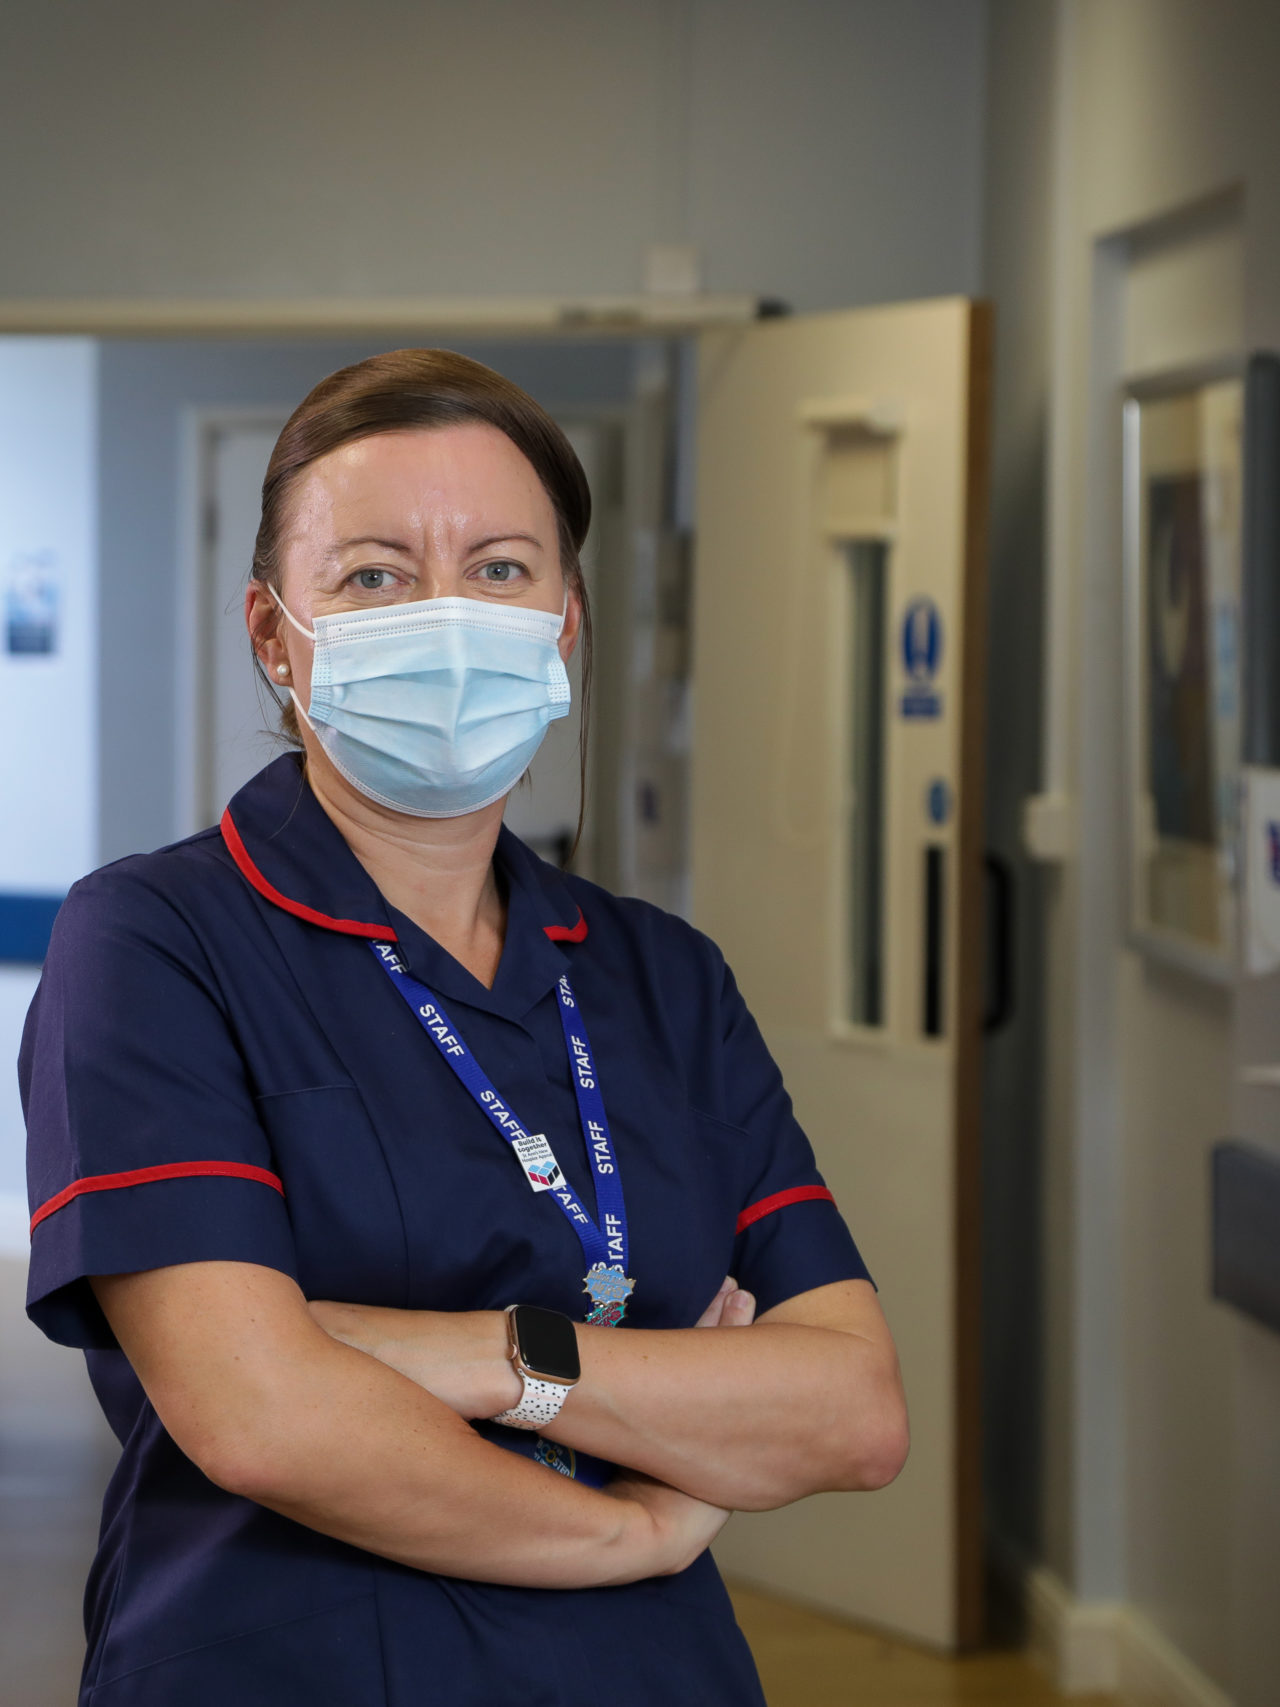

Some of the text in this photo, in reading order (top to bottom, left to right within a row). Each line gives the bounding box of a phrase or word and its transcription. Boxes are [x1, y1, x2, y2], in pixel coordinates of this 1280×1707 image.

[558, 974, 575, 1008] STA
[373, 940, 408, 974] AFF
[420, 1003, 464, 1057] STAFF
[480, 1090, 527, 1140] STAFF
[571, 1035, 595, 1089] STAFF
[517, 1138, 535, 1147] Build
[517, 1142, 547, 1153] together
[588, 1121, 614, 1174] STAFF
